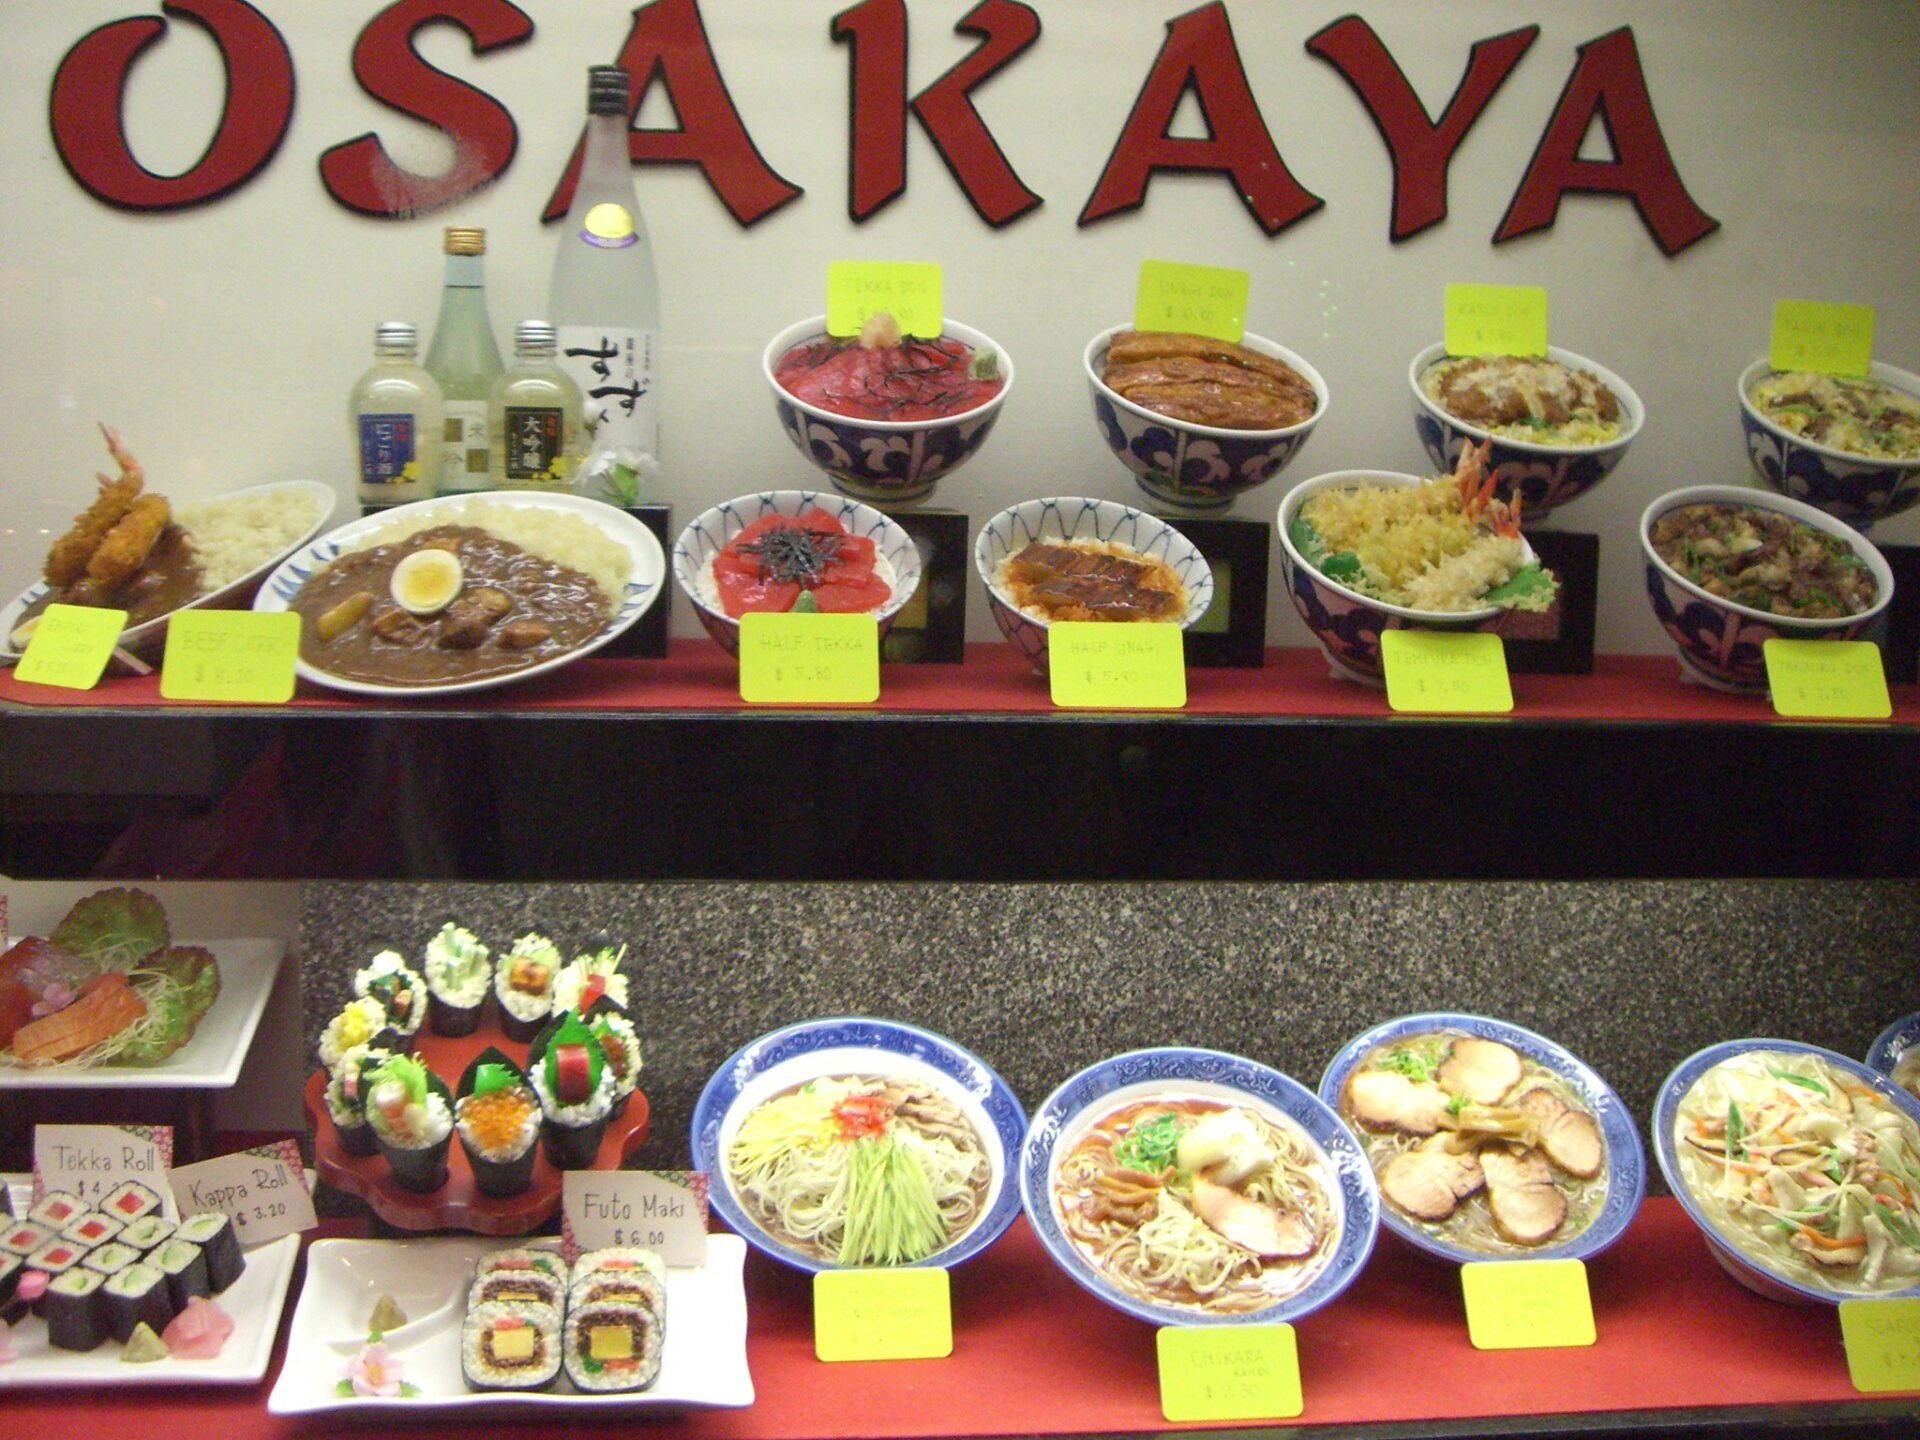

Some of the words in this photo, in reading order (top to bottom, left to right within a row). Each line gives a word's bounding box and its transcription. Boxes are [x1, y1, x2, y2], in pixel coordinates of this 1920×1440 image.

[50, 0, 1721, 259] OSAKAYA
[760, 633, 803, 652] HALF
[812, 636, 864, 652] TEKKA
[1070, 641, 1107, 654] HALF
[51, 1145, 112, 1171] Tekka
[121, 1146, 155, 1171] Roll
[188, 1179, 249, 1209] Kappa
[251, 1163, 290, 1190] Roll
[253, 1201, 287, 1220] 3.20
[583, 1192, 632, 1220] Futo
[643, 1193, 686, 1219] Maki
[614, 1227, 625, 1246] $
[630, 1229, 665, 1246] 6.00
[1189, 1348, 1264, 1368] CHIKARA
